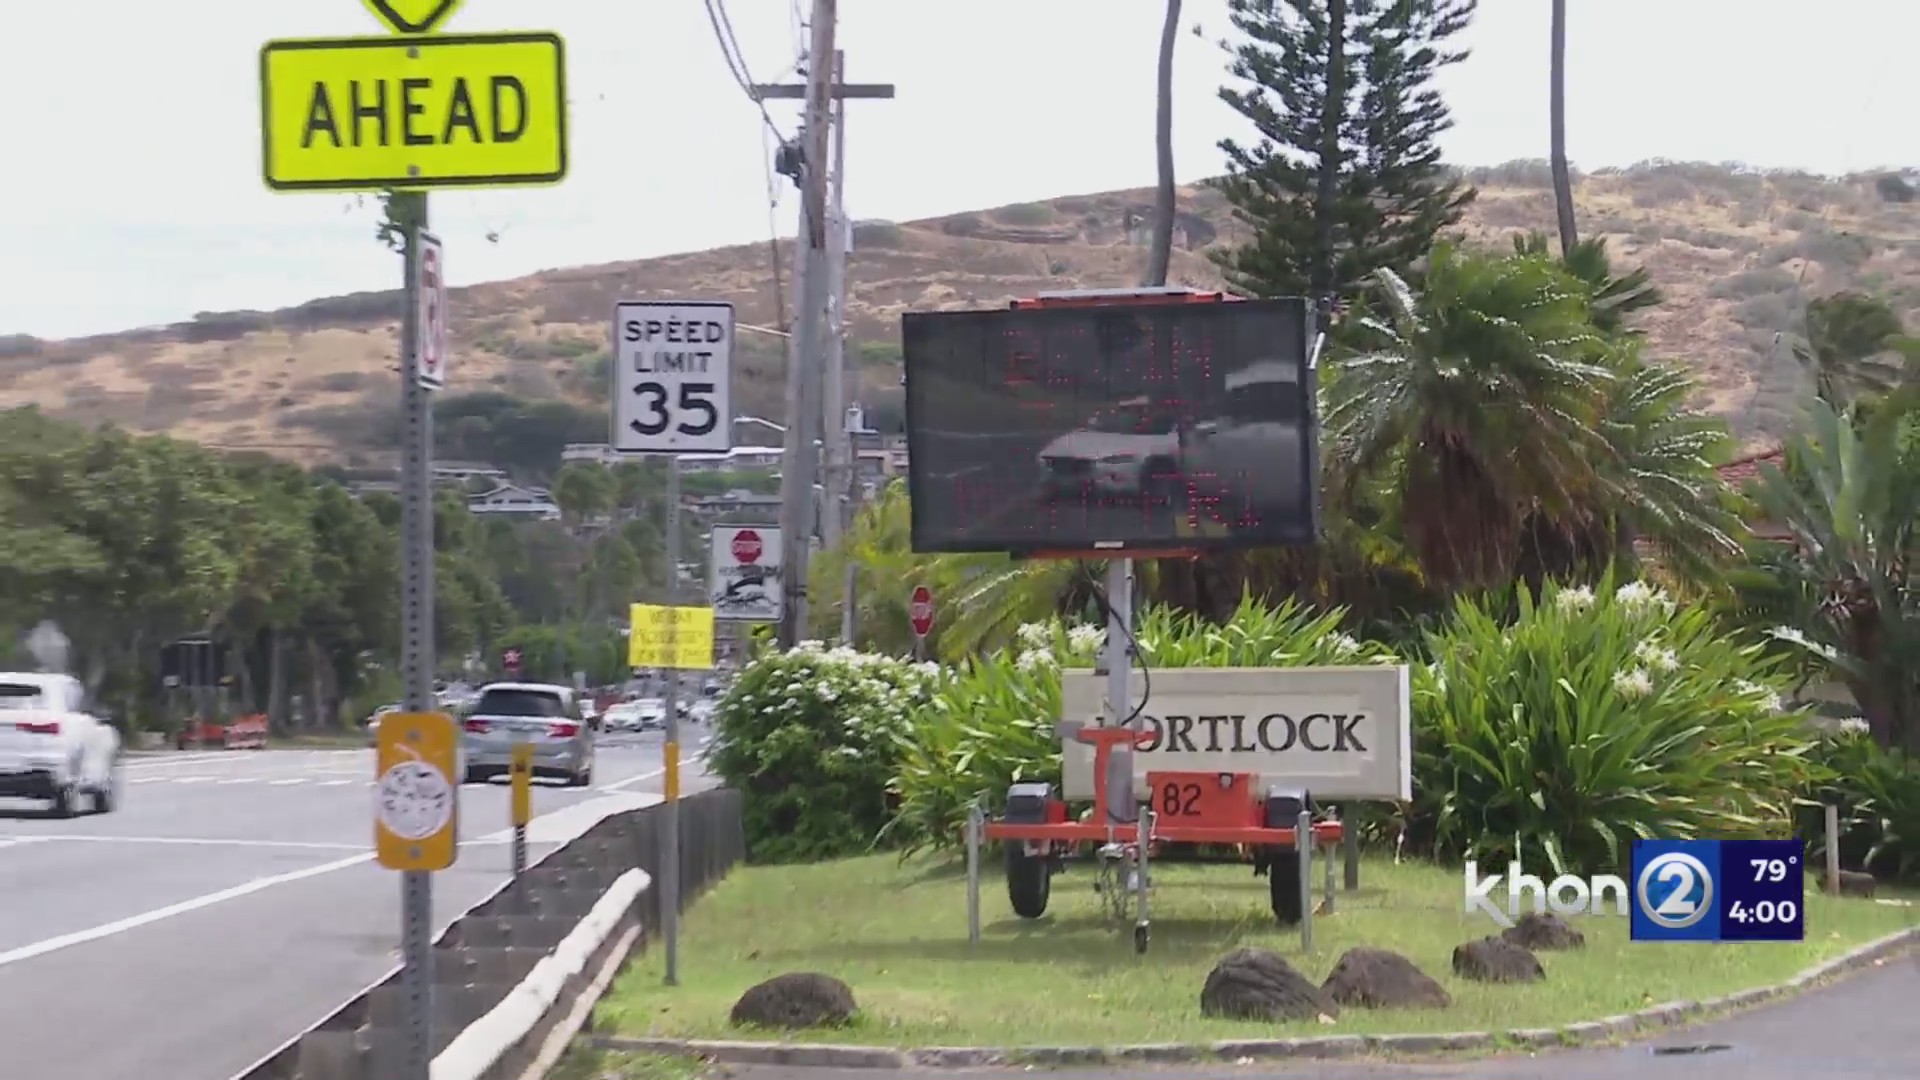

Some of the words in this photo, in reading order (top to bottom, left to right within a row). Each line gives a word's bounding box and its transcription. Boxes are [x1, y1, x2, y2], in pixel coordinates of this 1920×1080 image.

[301, 75, 529, 148] AHEAD
[624, 320, 724, 343] SPEED
[634, 352, 713, 373] LIMIT
[630, 382, 719, 436] 35
[1097, 713, 1368, 753] ORTLOCK
[1163, 783, 1202, 816] 82
